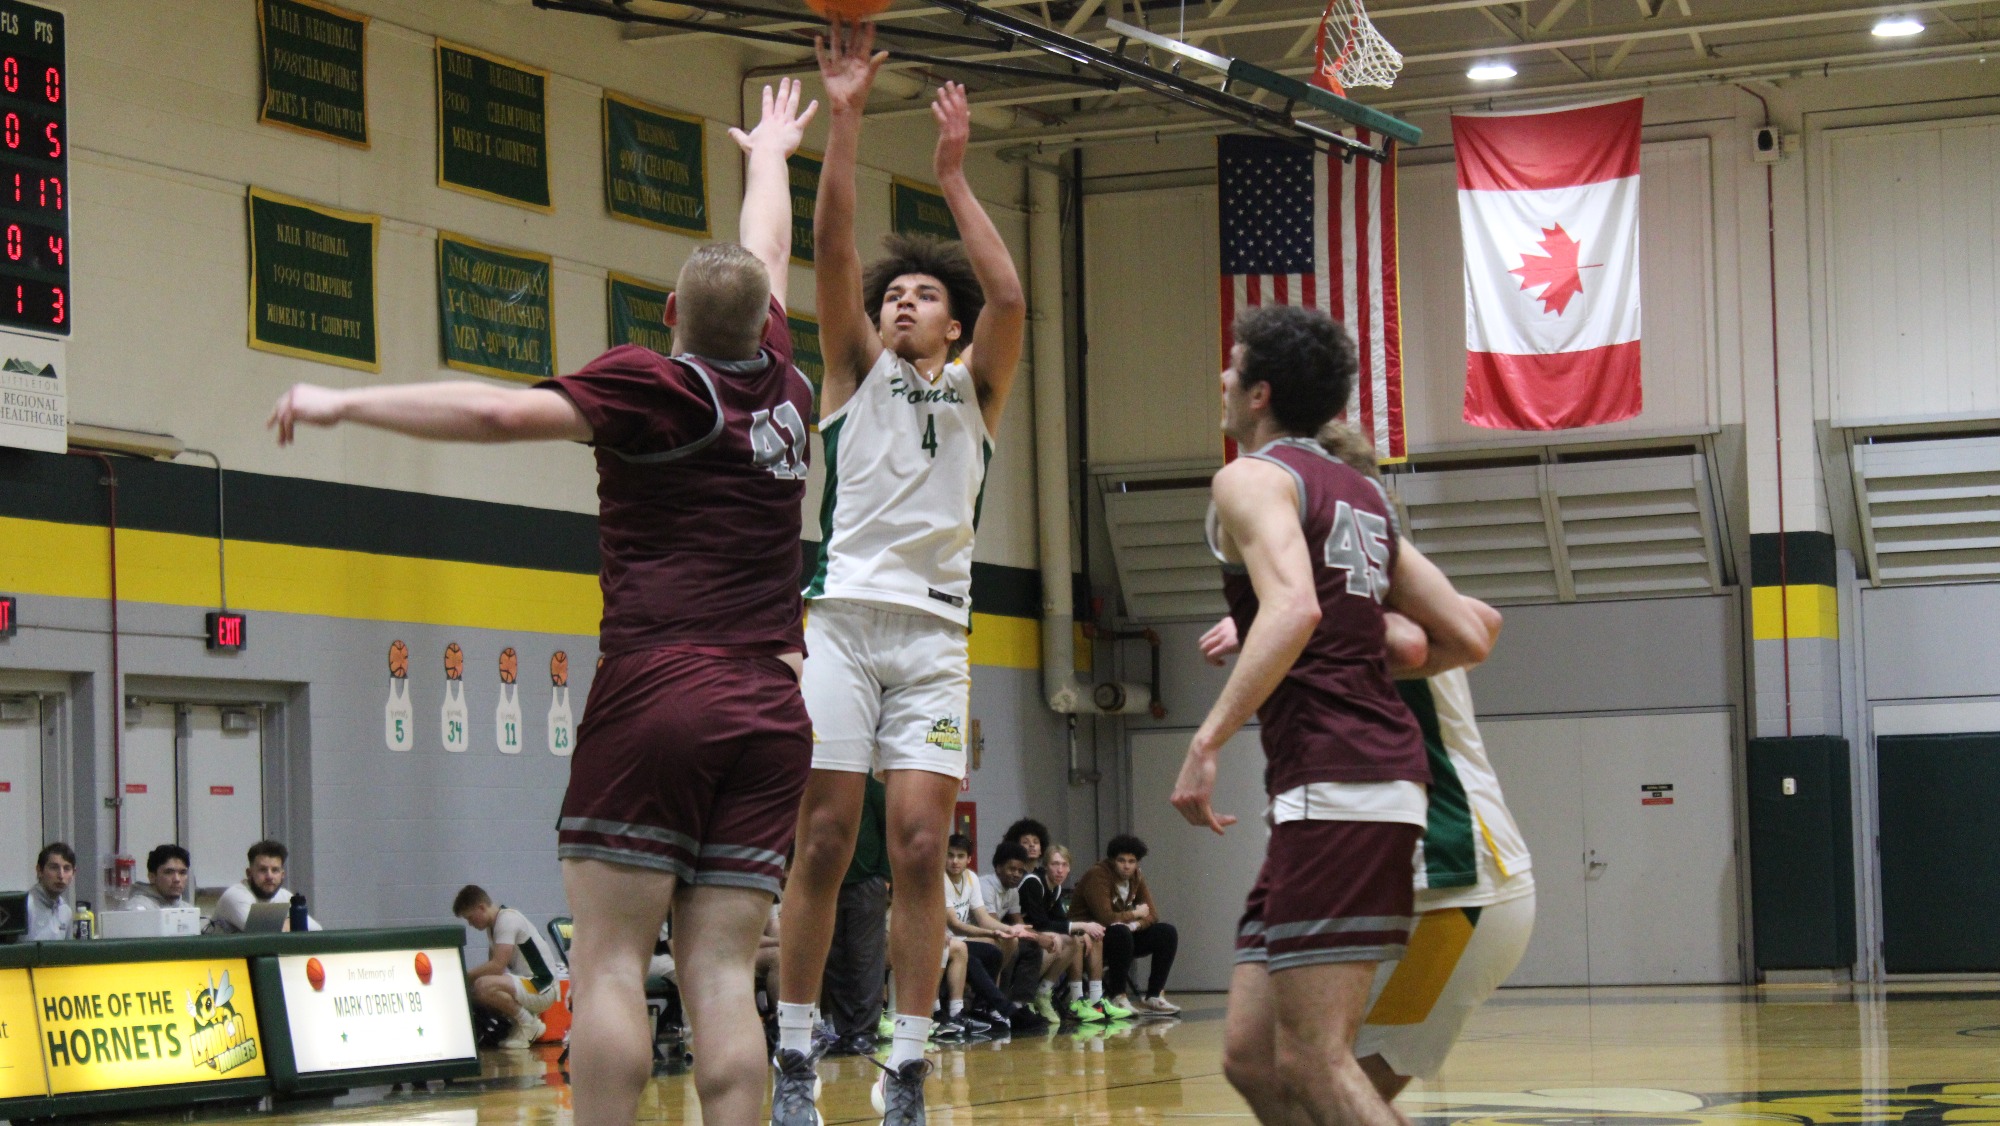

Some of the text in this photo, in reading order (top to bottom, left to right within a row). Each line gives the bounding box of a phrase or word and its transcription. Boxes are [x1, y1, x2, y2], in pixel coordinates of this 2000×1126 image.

[1, 11, 54, 44] FLS PTS
[270, 5, 357, 51] NAIA REGIONAL
[4, 57, 60, 103] 0 0
[447, 51, 538, 98] NAIA REGIONAL
[313, 100, 363, 133] COUNTRY
[487, 101, 543, 134] CHAMPIONS
[5, 113, 61, 158] 0 5
[495, 137, 539, 168] COUNTRY
[14, 173, 62, 210] 1 17
[7, 224, 63, 265] 0 4
[276, 223, 349, 257] NAIA REGIONAL
[272, 263, 354, 299] 1999 CHAMPIONS
[17, 285, 64, 324] 1 3
[321, 315, 361, 340] COUNTRY
[507, 335, 541, 363] PLACE
[4, 392, 58, 412] REGIONAL
[750, 400, 808, 480] 41
[921, 413, 938, 458] 4
[1324, 500, 1390, 605] 45
[218, 616, 242, 646] EXIT
[395, 719, 404, 743] 5
[447, 720, 462, 744] 34
[504, 722, 517, 746] 11
[555, 727, 568, 749] 23
[357, 967, 387, 982] Memory
[388, 965, 395, 980] of
[43, 990, 174, 1022] HOME OF THE
[334, 995, 364, 1018] MARK
[366, 992, 405, 1015] O'BRIEN
[47, 1023, 182, 1067] HORNETS
